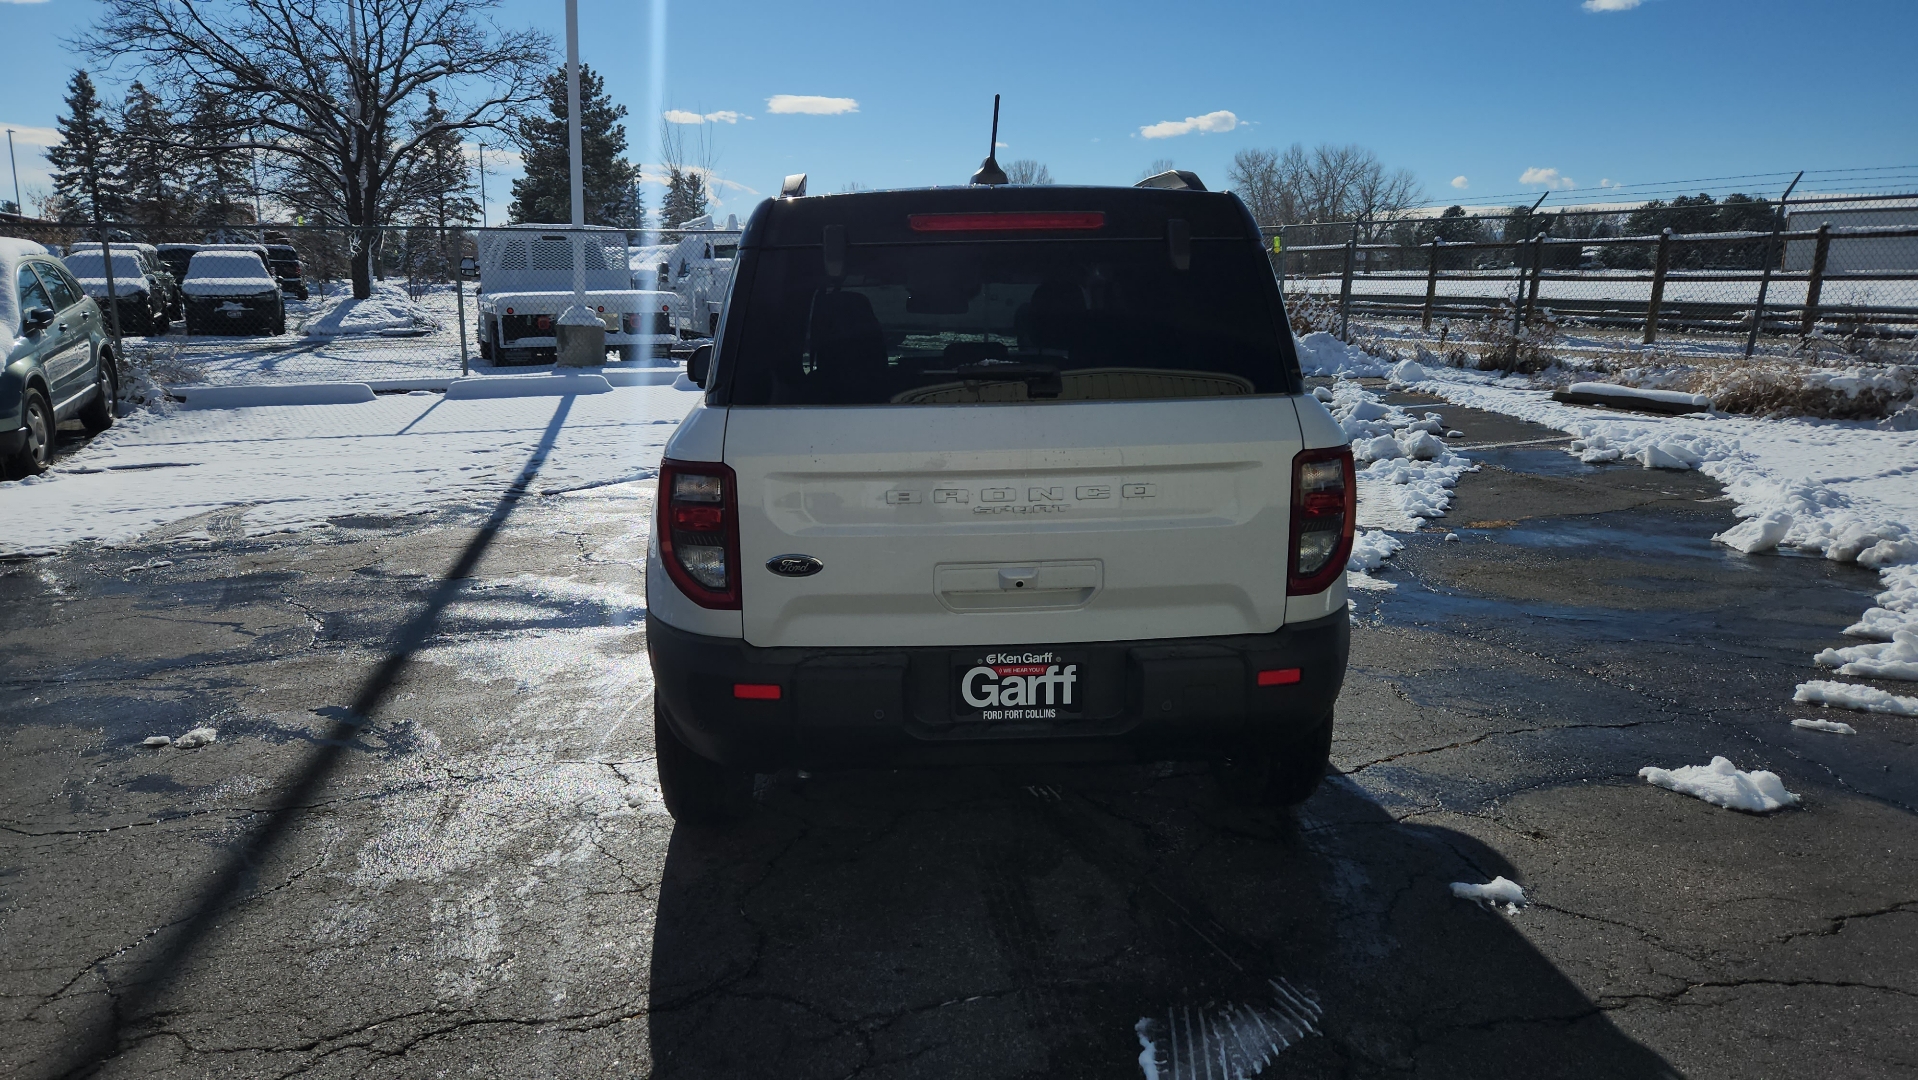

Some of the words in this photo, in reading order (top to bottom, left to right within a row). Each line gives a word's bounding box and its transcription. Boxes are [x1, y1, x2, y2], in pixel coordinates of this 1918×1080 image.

[886, 483, 1157, 504] BRONCO
[973, 504, 1071, 514] SPORT
[779, 559, 809, 572] Ford
[997, 653, 1021, 664] Ken
[1022, 652, 1053, 664] Garff
[962, 664, 1077, 708] Garff
[983, 710, 1003, 720] FORD
[1005, 709, 1024, 719] FORT
[1025, 708, 1056, 719] COLLINS
